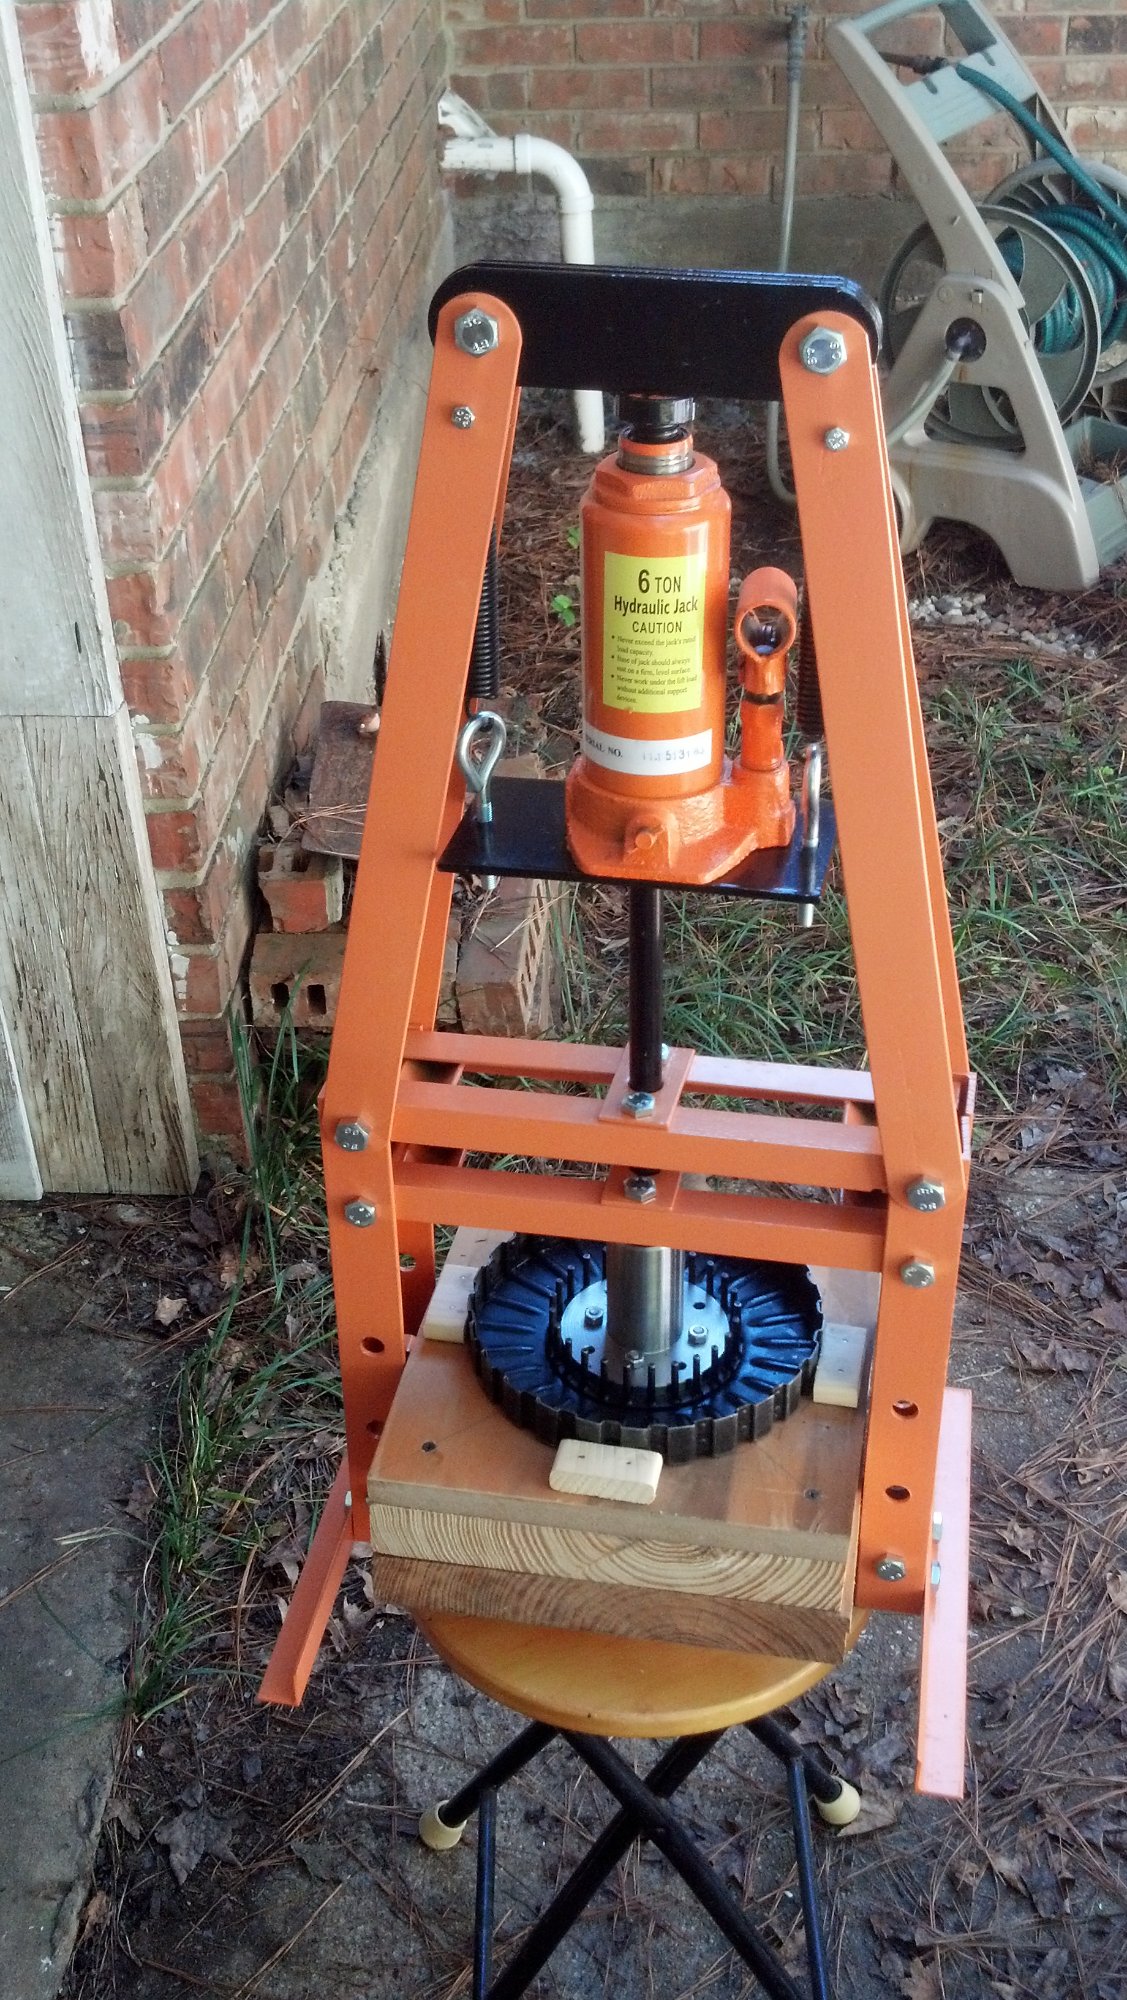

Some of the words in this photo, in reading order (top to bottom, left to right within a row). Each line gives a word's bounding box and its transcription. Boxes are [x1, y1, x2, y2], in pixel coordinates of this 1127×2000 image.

[638, 569, 650, 594] 6
[655, 576, 682, 594] TON
[614, 595, 670, 617] Hydraulic
[673, 595, 698, 614] Jack
[632, 621, 682, 634] CAUTION
